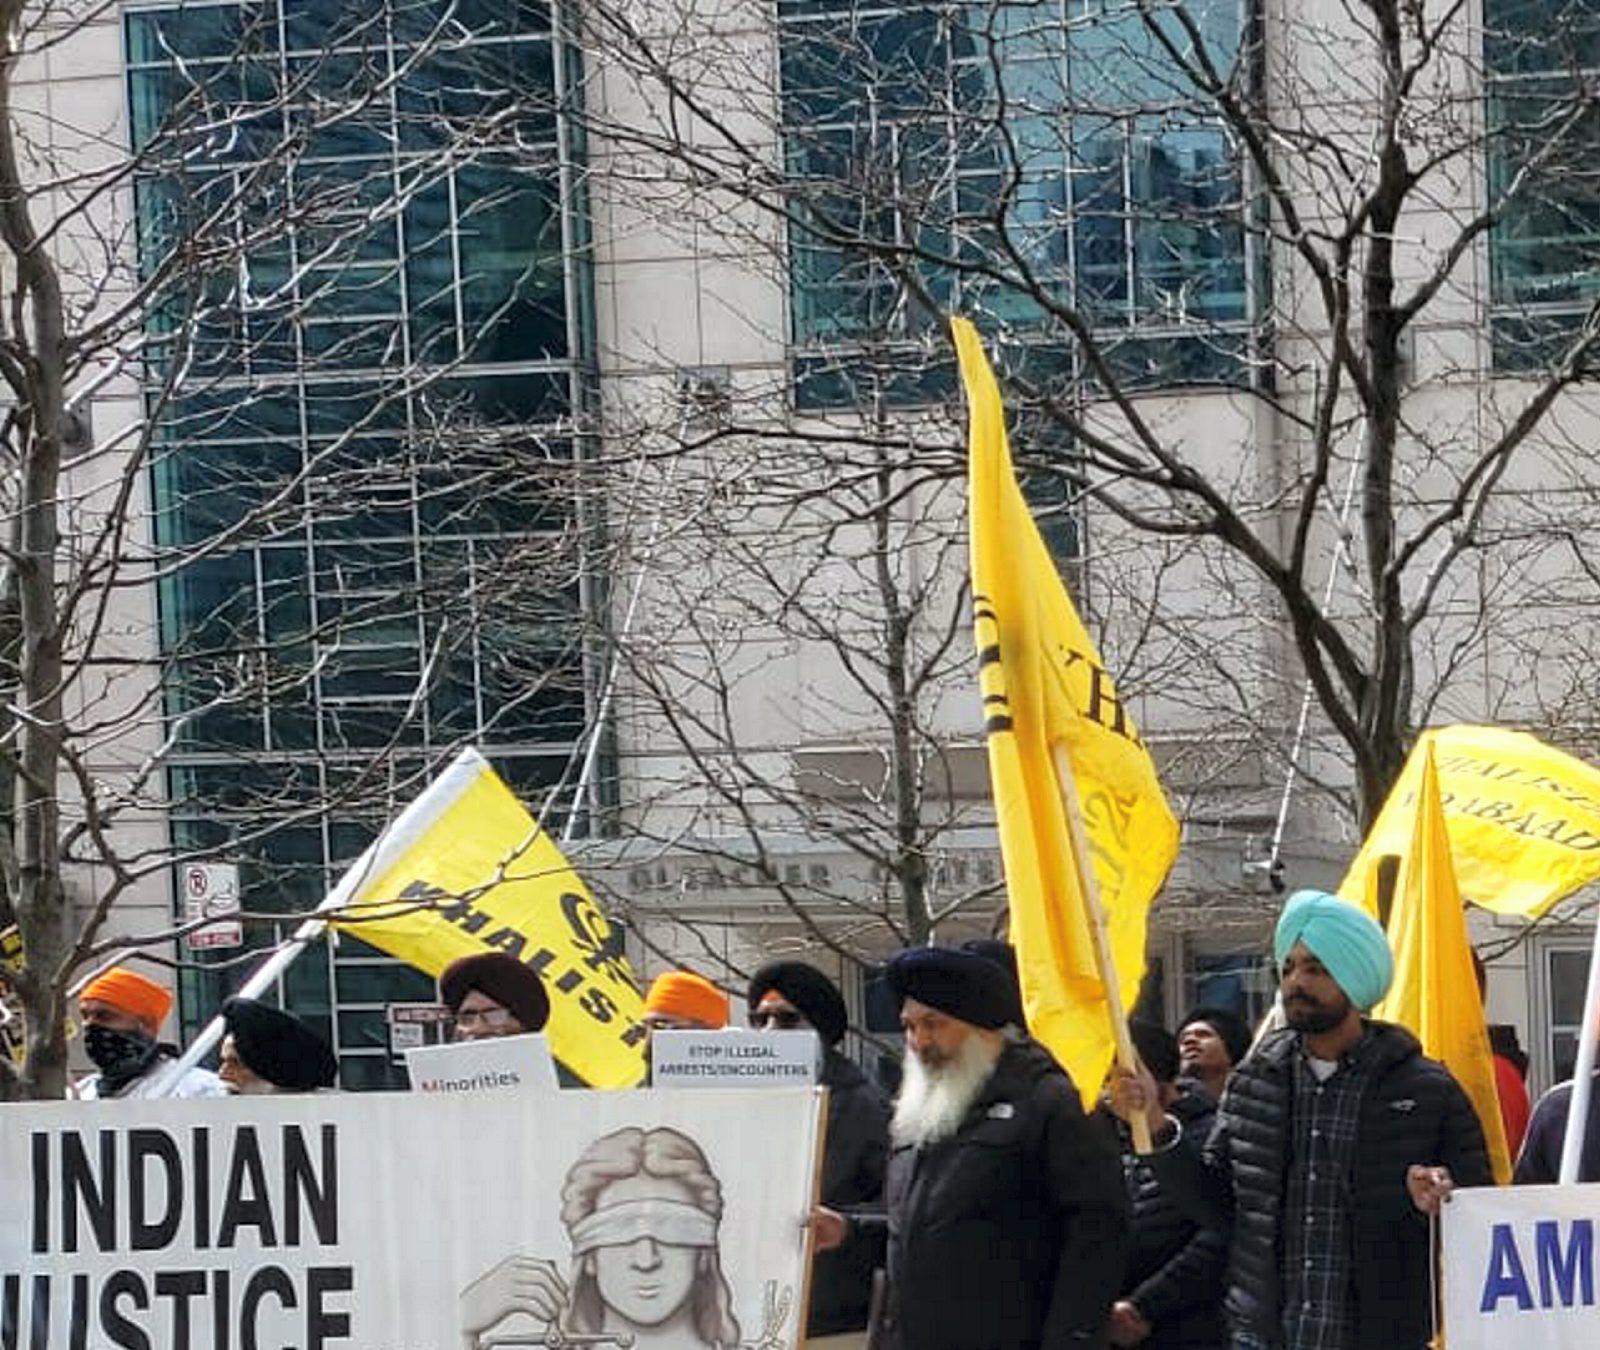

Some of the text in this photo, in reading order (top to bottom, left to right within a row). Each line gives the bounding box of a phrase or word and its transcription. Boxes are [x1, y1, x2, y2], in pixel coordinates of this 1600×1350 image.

[689, 1045, 779, 1058] STOP ILLEGAL
[421, 1071, 520, 1093] Minorities
[31, 1123, 339, 1253] INDIAN
